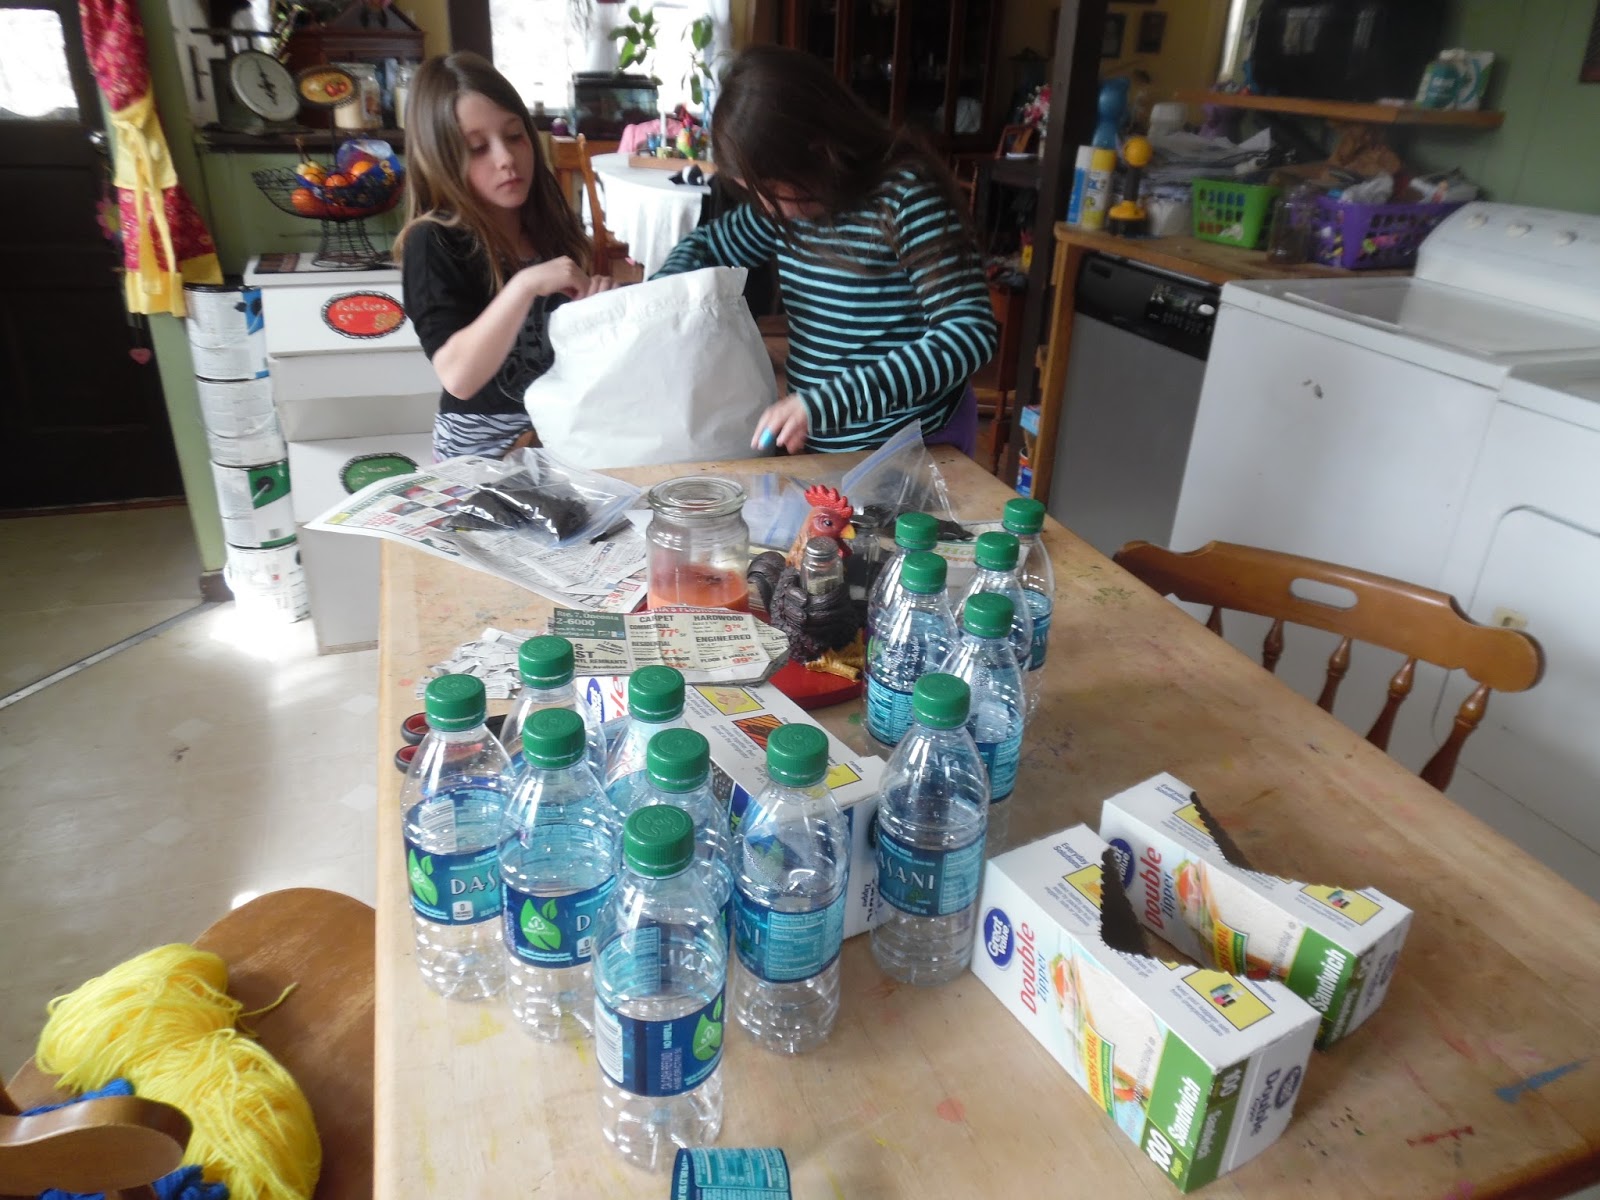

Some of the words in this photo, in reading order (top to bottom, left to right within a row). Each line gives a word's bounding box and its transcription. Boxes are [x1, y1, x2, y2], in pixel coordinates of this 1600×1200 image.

[639, 614, 674, 623] CARPET
[695, 634, 752, 643] ENGINEERED
[575, 650, 595, 659] ST
[1053, 845, 1083, 869] Solutions
[1061, 842, 1089, 865] Everyday
[450, 865, 499, 896] DAS
[880, 850, 935, 890] ASANI
[1139, 847, 1165, 930] Double
[987, 915, 1004, 957] Great
[998, 924, 1010, 955] Value
[1016, 922, 1037, 1015] Double
[1307, 947, 1347, 1013] Sandwich
[1087, 1033, 1098, 1061] SEAL
[1088, 1063, 1100, 1101] FRESH
[1219, 1068, 1242, 1097] 100
[1168, 1076, 1201, 1147] Sandwich
[1146, 1128, 1174, 1173] 100
